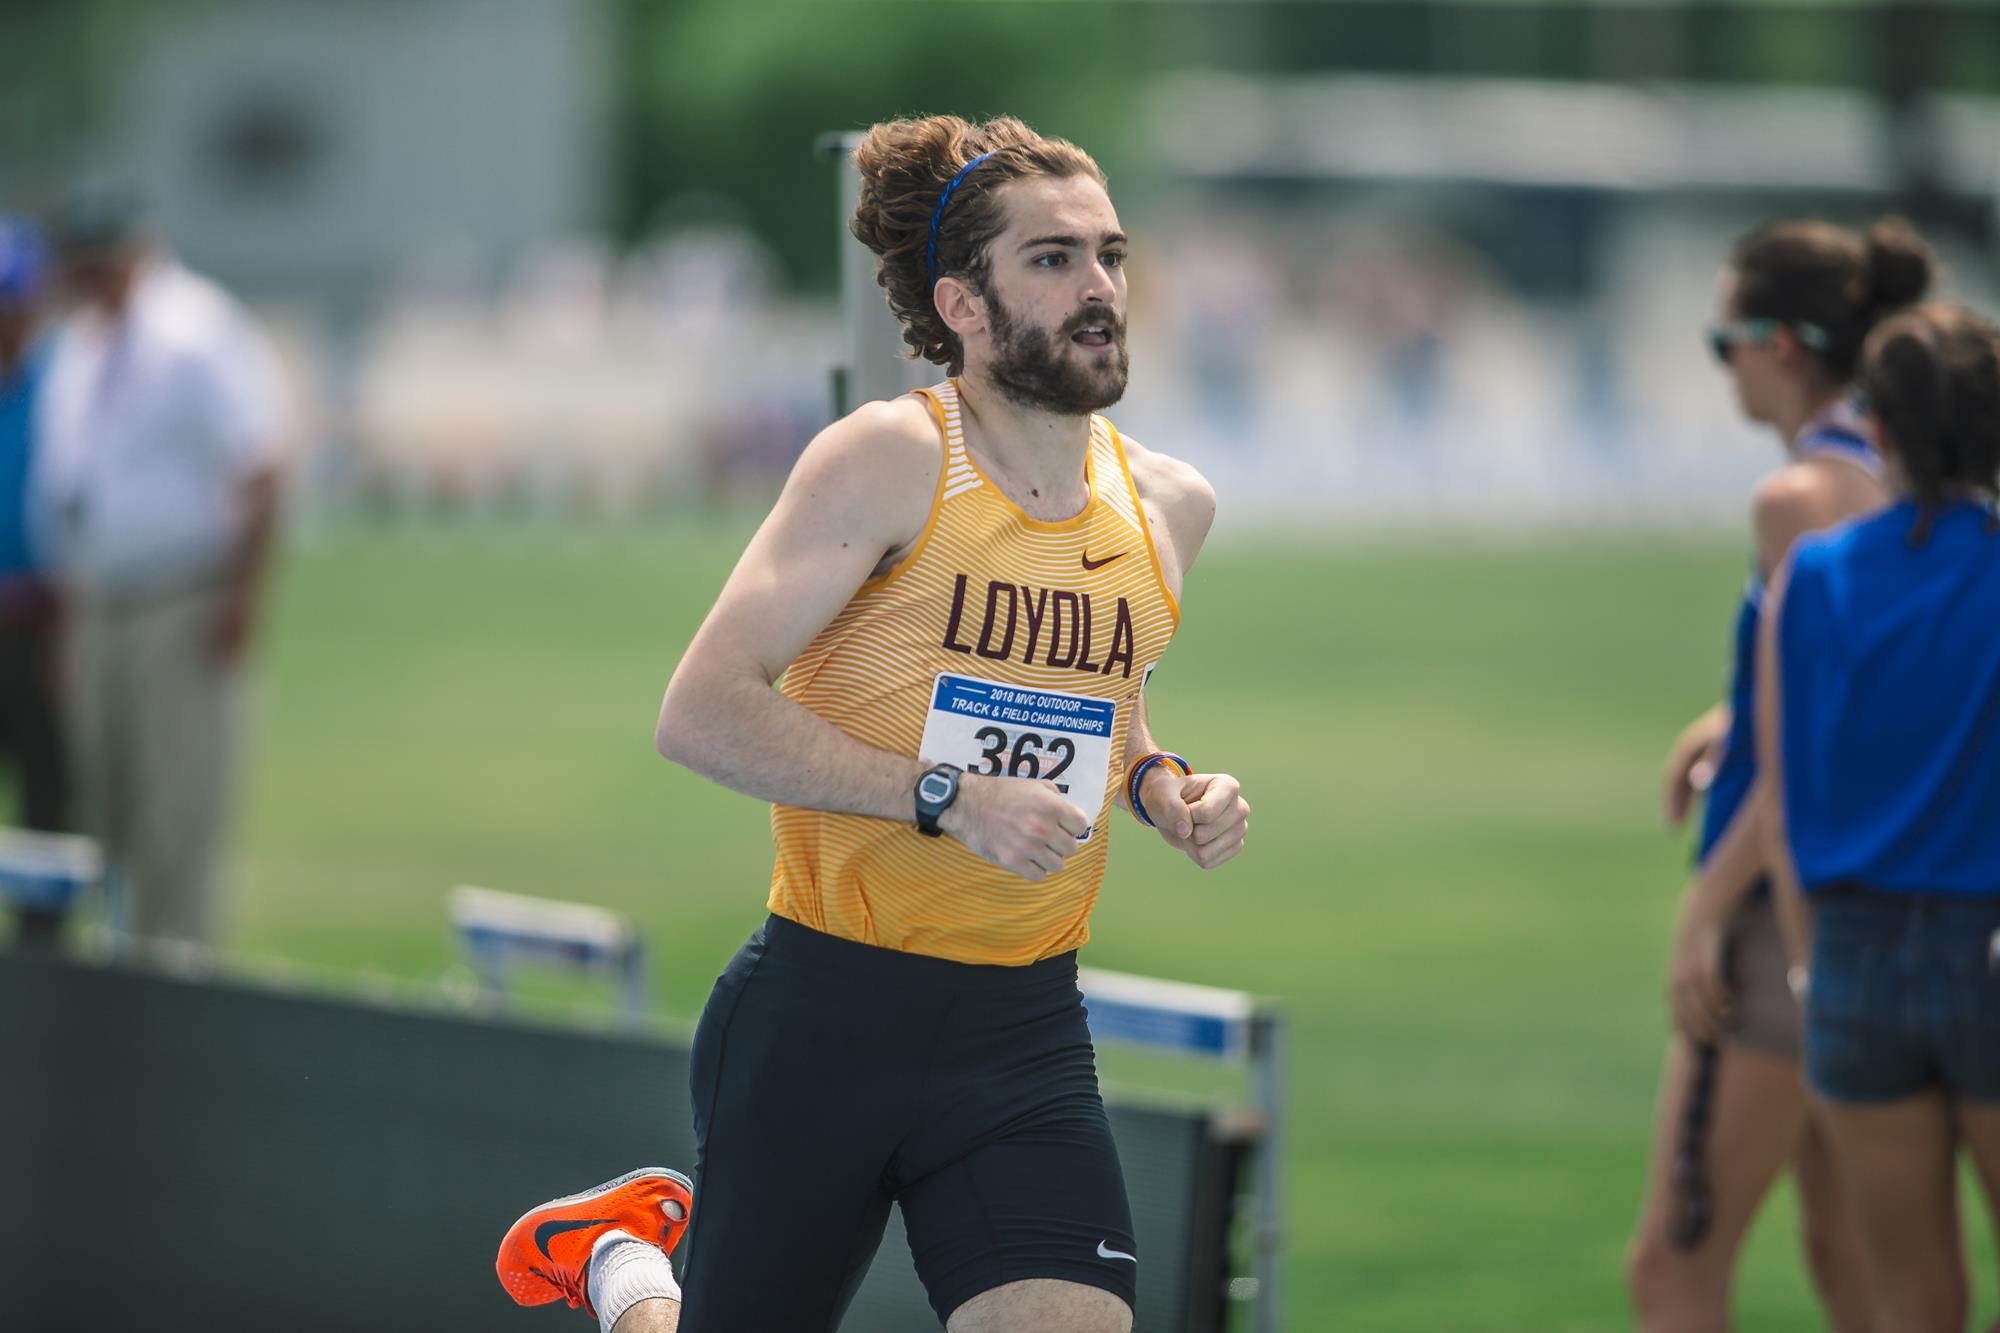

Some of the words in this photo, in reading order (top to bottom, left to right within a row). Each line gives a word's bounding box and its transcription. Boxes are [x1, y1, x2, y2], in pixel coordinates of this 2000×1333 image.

[942, 573, 1134, 678] LOYOLA
[951, 697, 991, 716] TRACK
[991, 705, 1000, 717] &
[1001, 707, 1030, 721] FIELD
[1030, 711, 1104, 732] CHAMPIONSHIPS
[990, 688, 1014, 703] 2018
[1014, 692, 1037, 706] MVC
[1036, 695, 1081, 712] OUTDOOR
[967, 726, 1076, 793] 362
